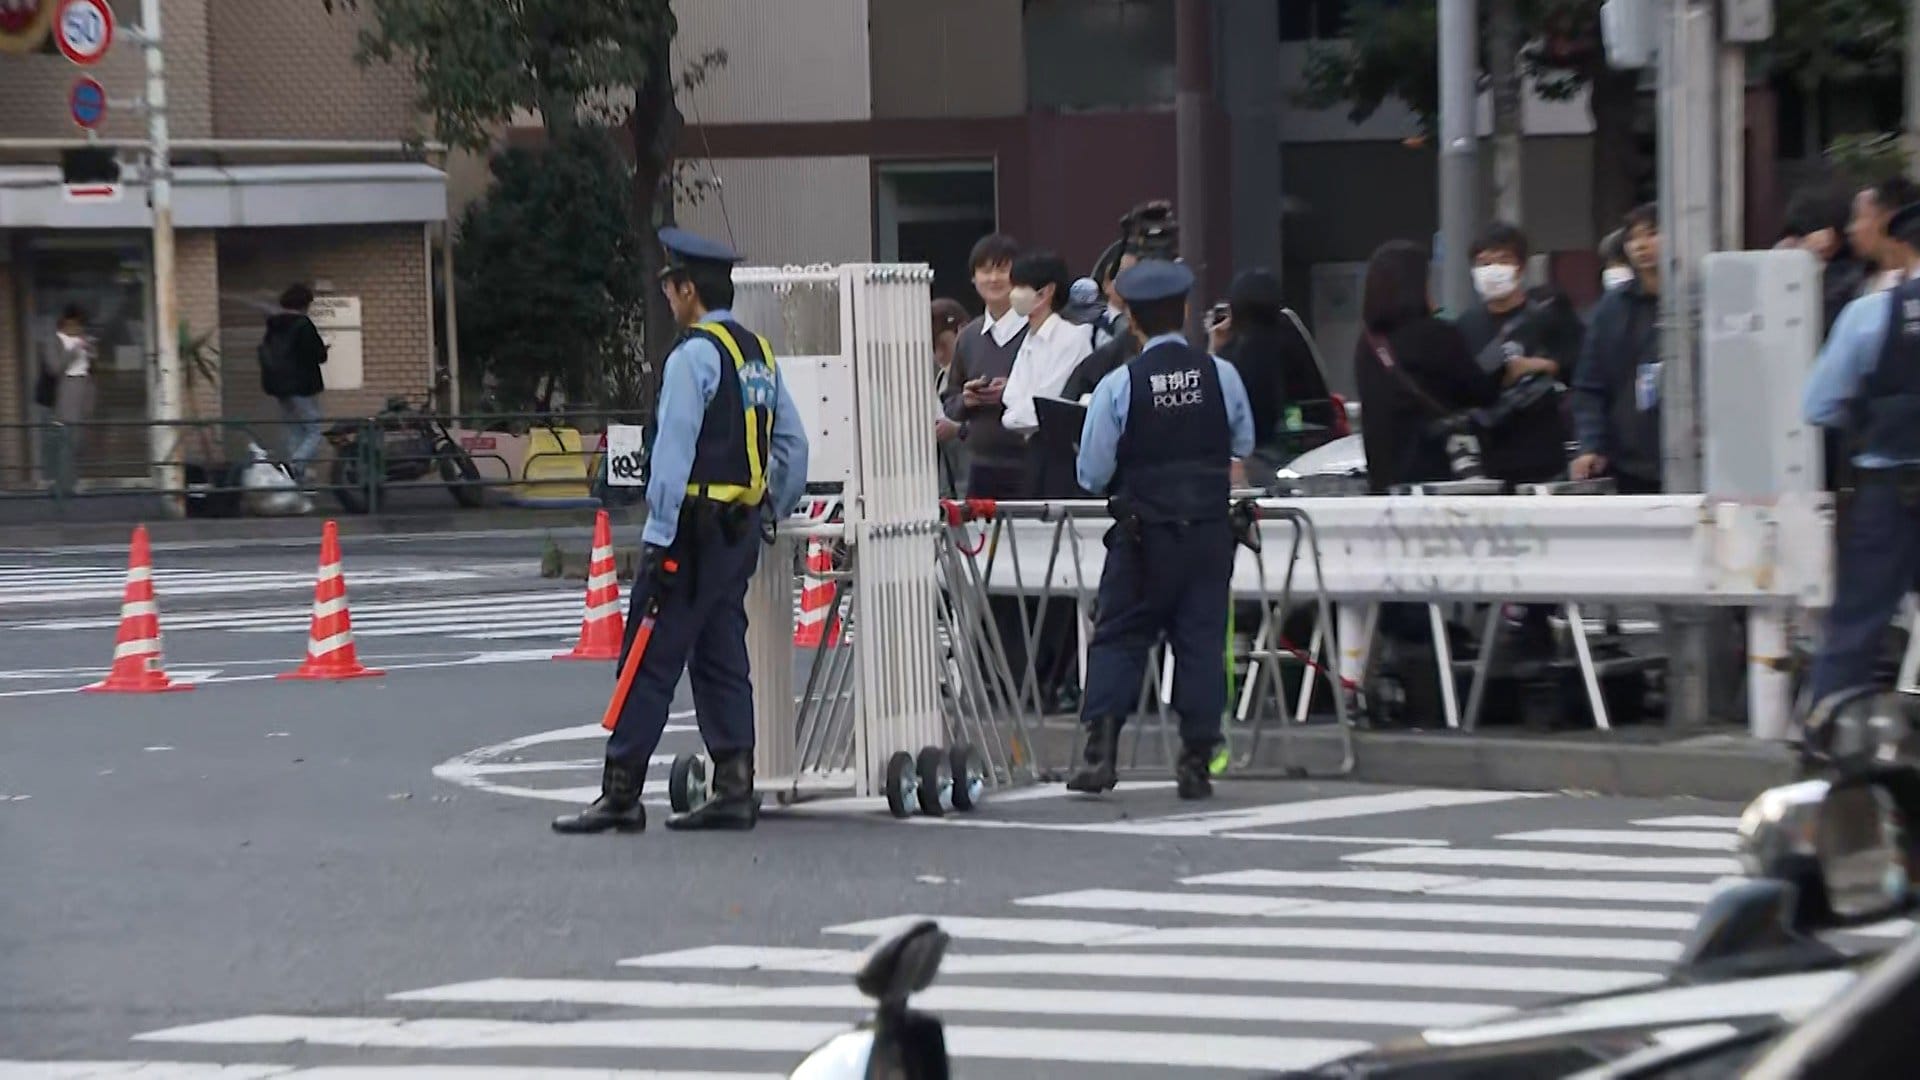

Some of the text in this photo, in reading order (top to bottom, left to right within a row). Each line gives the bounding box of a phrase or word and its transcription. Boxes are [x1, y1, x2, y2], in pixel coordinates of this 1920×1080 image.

[66, 10, 99, 43] 50
[1150, 370, 1201, 392] 警視庁
[1153, 391, 1202, 407] POLICE
